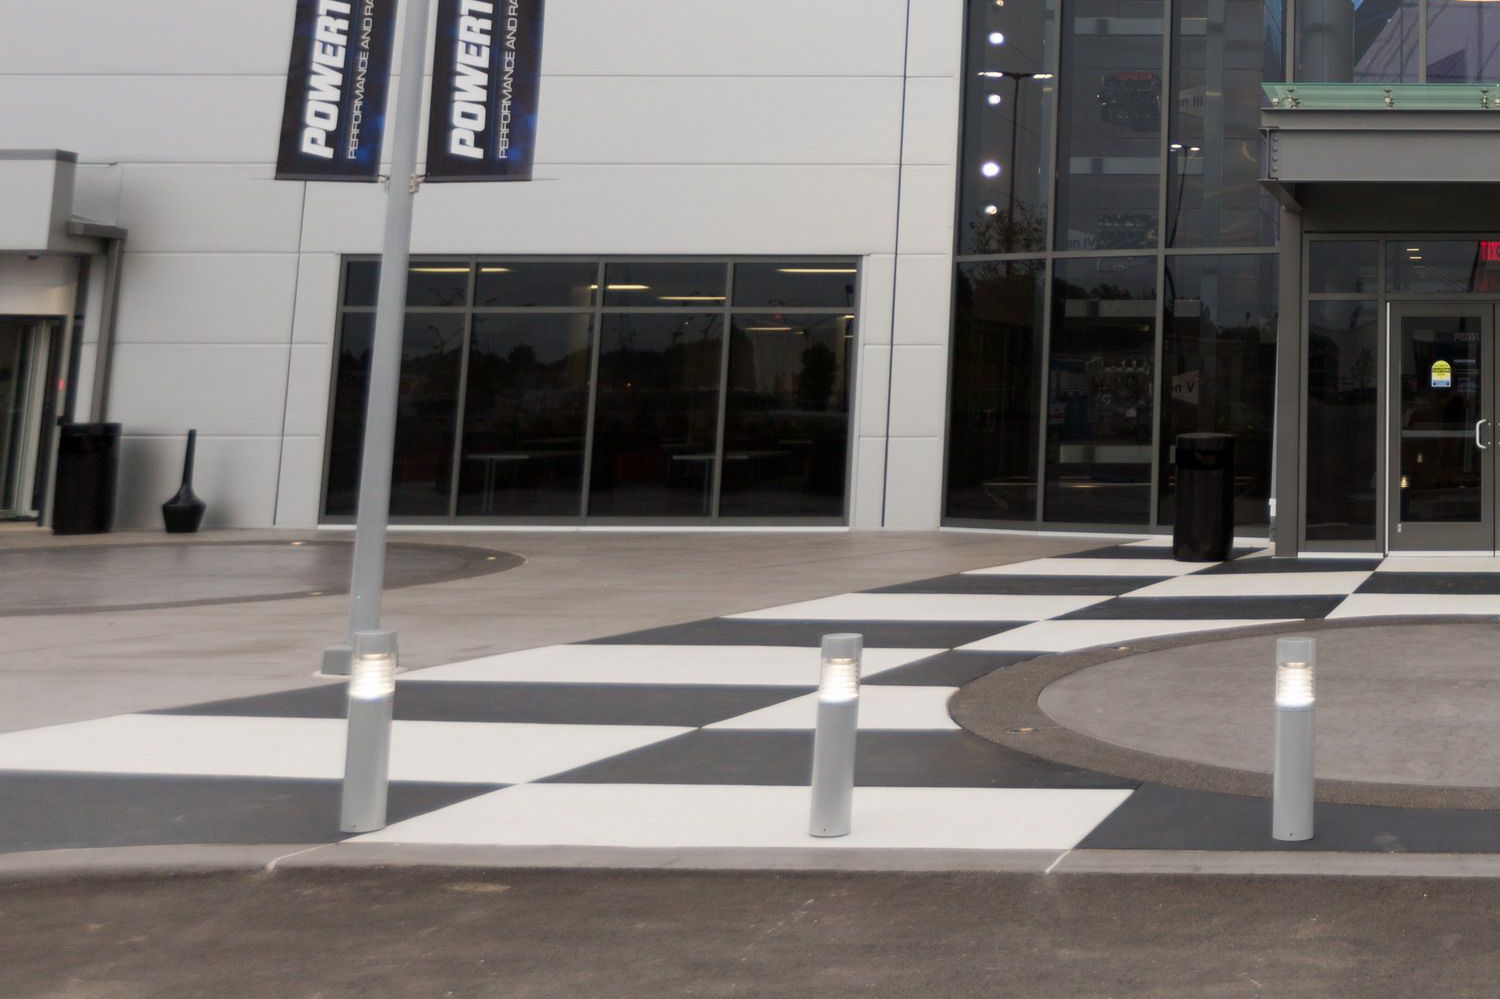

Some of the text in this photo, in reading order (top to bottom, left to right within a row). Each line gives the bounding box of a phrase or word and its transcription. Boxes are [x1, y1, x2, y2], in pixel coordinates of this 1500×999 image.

[506, 18, 518, 49] AND
[348, 51, 369, 159] PERFORMANCE
[361, 18, 372, 49] AND
[499, 51, 516, 159] PERFORMANCE
